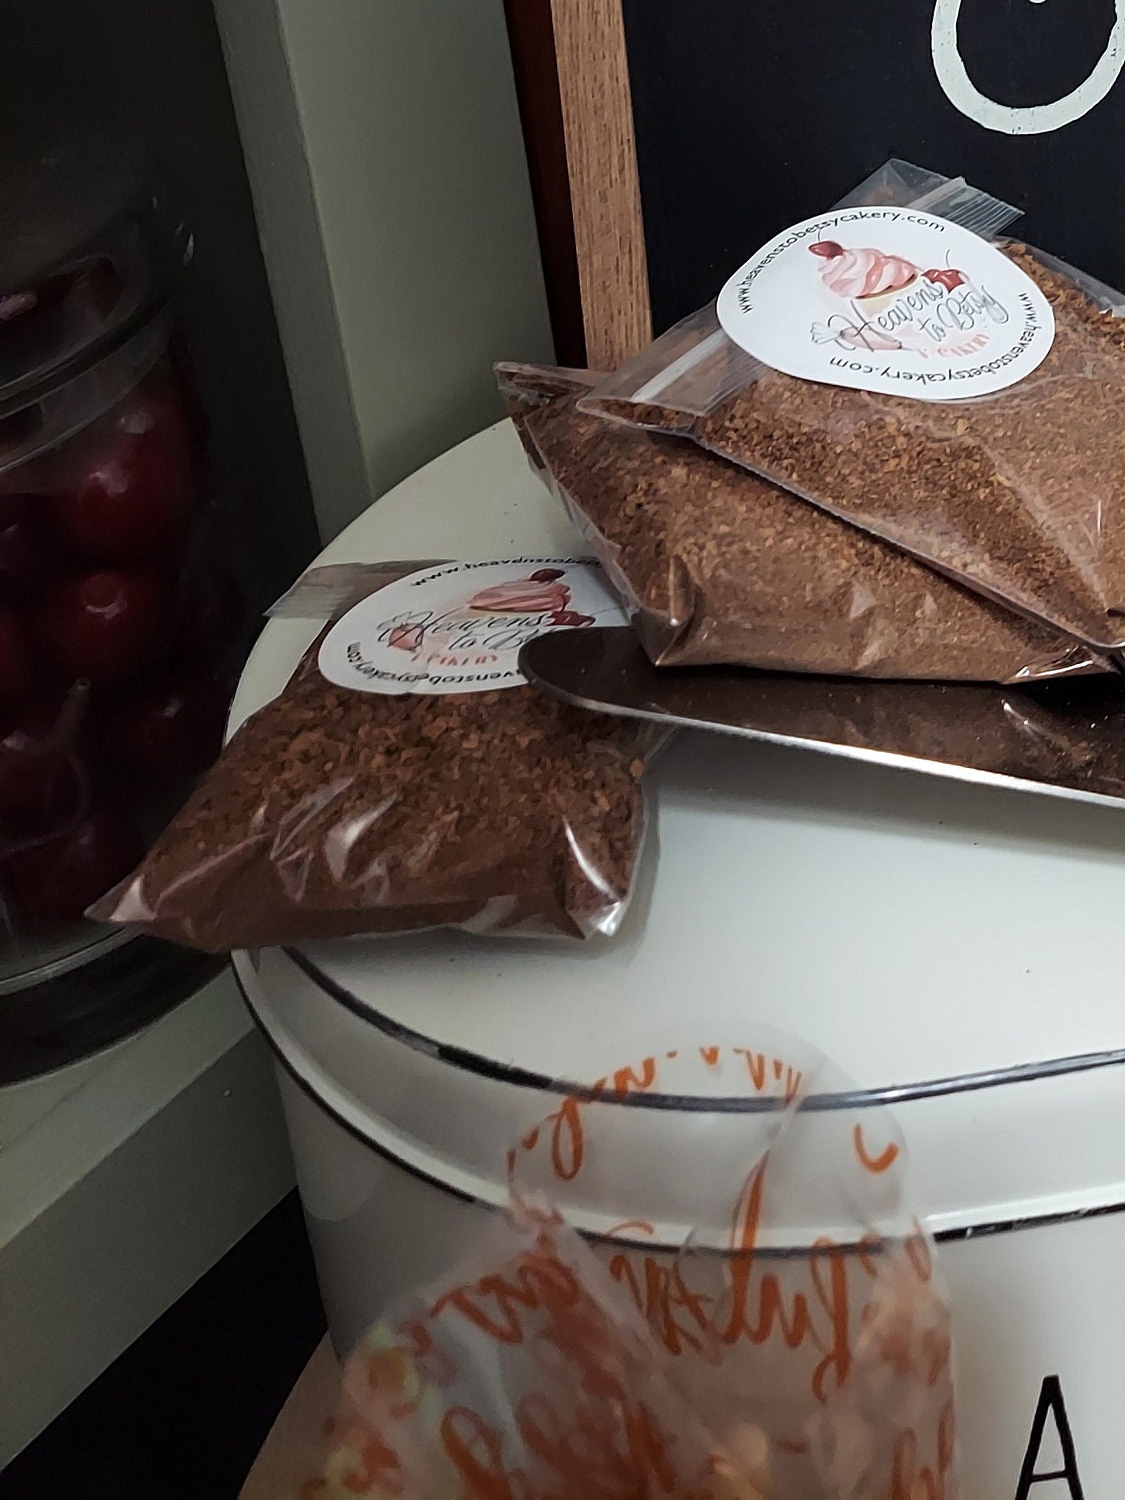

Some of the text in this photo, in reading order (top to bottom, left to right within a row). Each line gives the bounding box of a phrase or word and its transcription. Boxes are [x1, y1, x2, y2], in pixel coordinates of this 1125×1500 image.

[737, 210, 945, 315] www.heavenstobetsycakery.com
[827, 279, 944, 352] Heavens
[829, 292, 1043, 385] www.heavenstobetsycakery.com
[916, 285, 1009, 343] to Betsy
